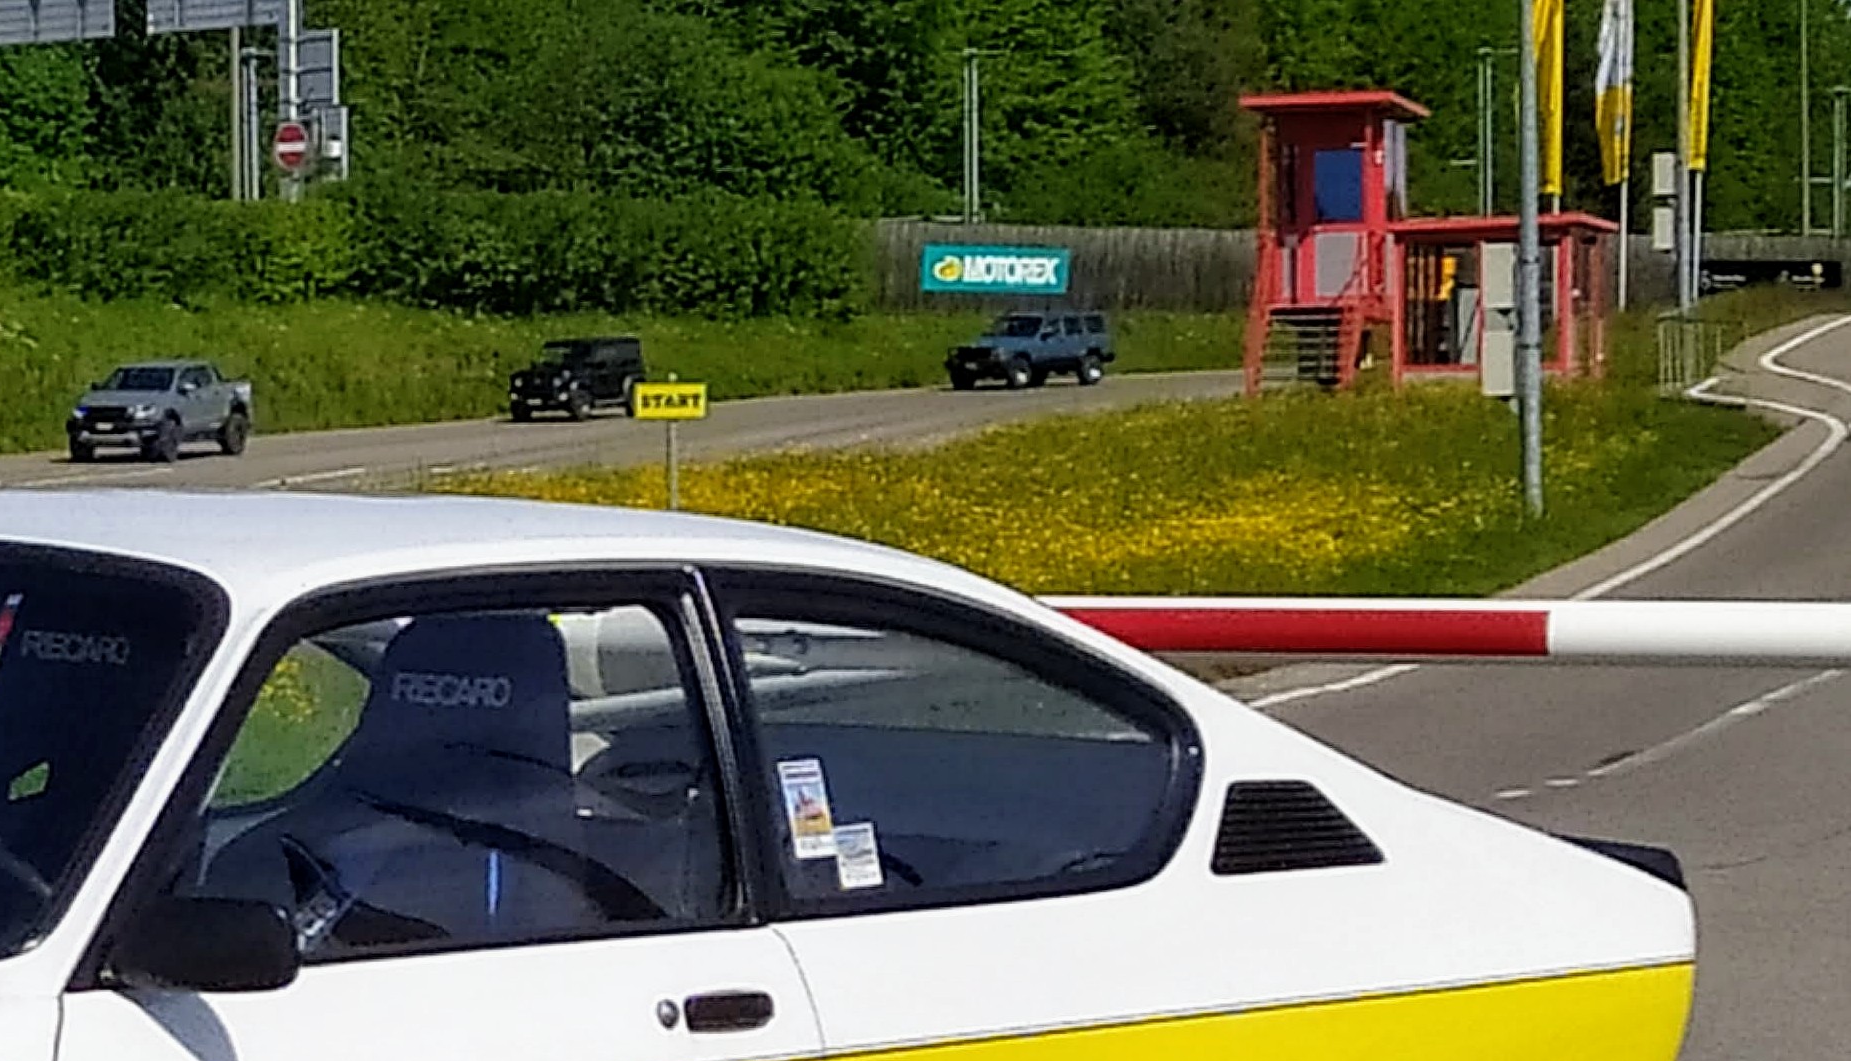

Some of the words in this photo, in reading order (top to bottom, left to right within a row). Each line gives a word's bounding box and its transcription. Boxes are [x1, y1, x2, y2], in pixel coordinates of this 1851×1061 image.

[963, 255, 1061, 285] MOTOREX
[642, 392, 702, 410] START
[391, 672, 511, 708] RECARO
